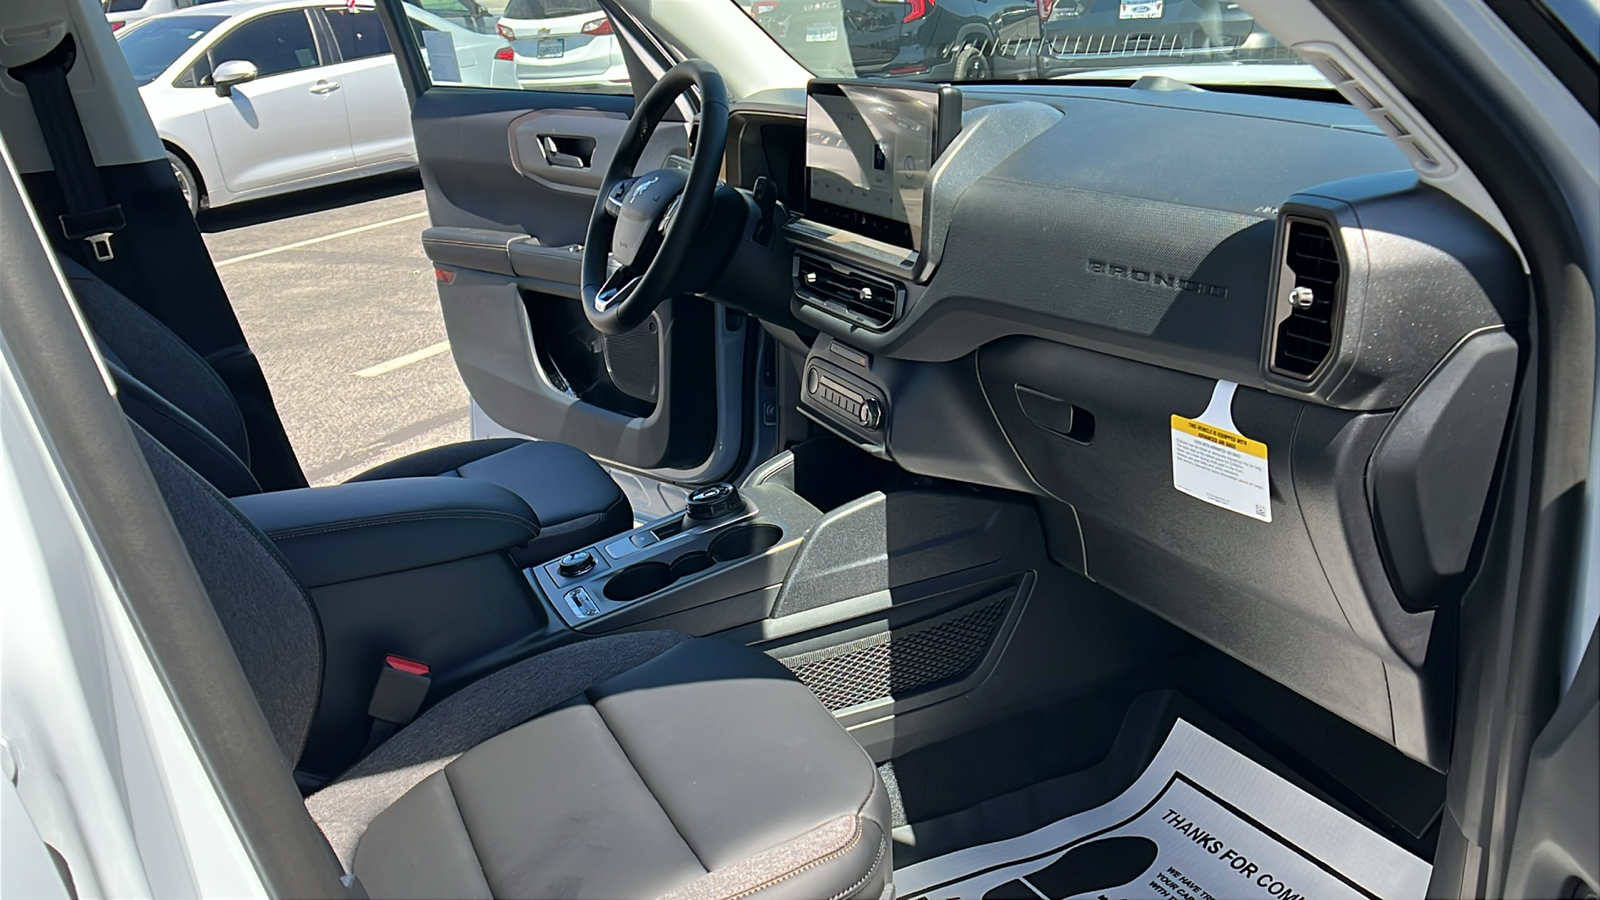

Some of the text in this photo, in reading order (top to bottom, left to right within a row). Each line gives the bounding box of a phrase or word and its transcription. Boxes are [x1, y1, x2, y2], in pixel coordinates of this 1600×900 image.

[1086, 258, 1228, 298] BRONCO
[1161, 808, 1307, 900] THANKS FOR COM
[1148, 881, 1171, 897] WITH
[1156, 872, 1180, 890] YOUR
[1166, 866, 1183, 878] WE
[1178, 876, 1203, 893] HAVE
